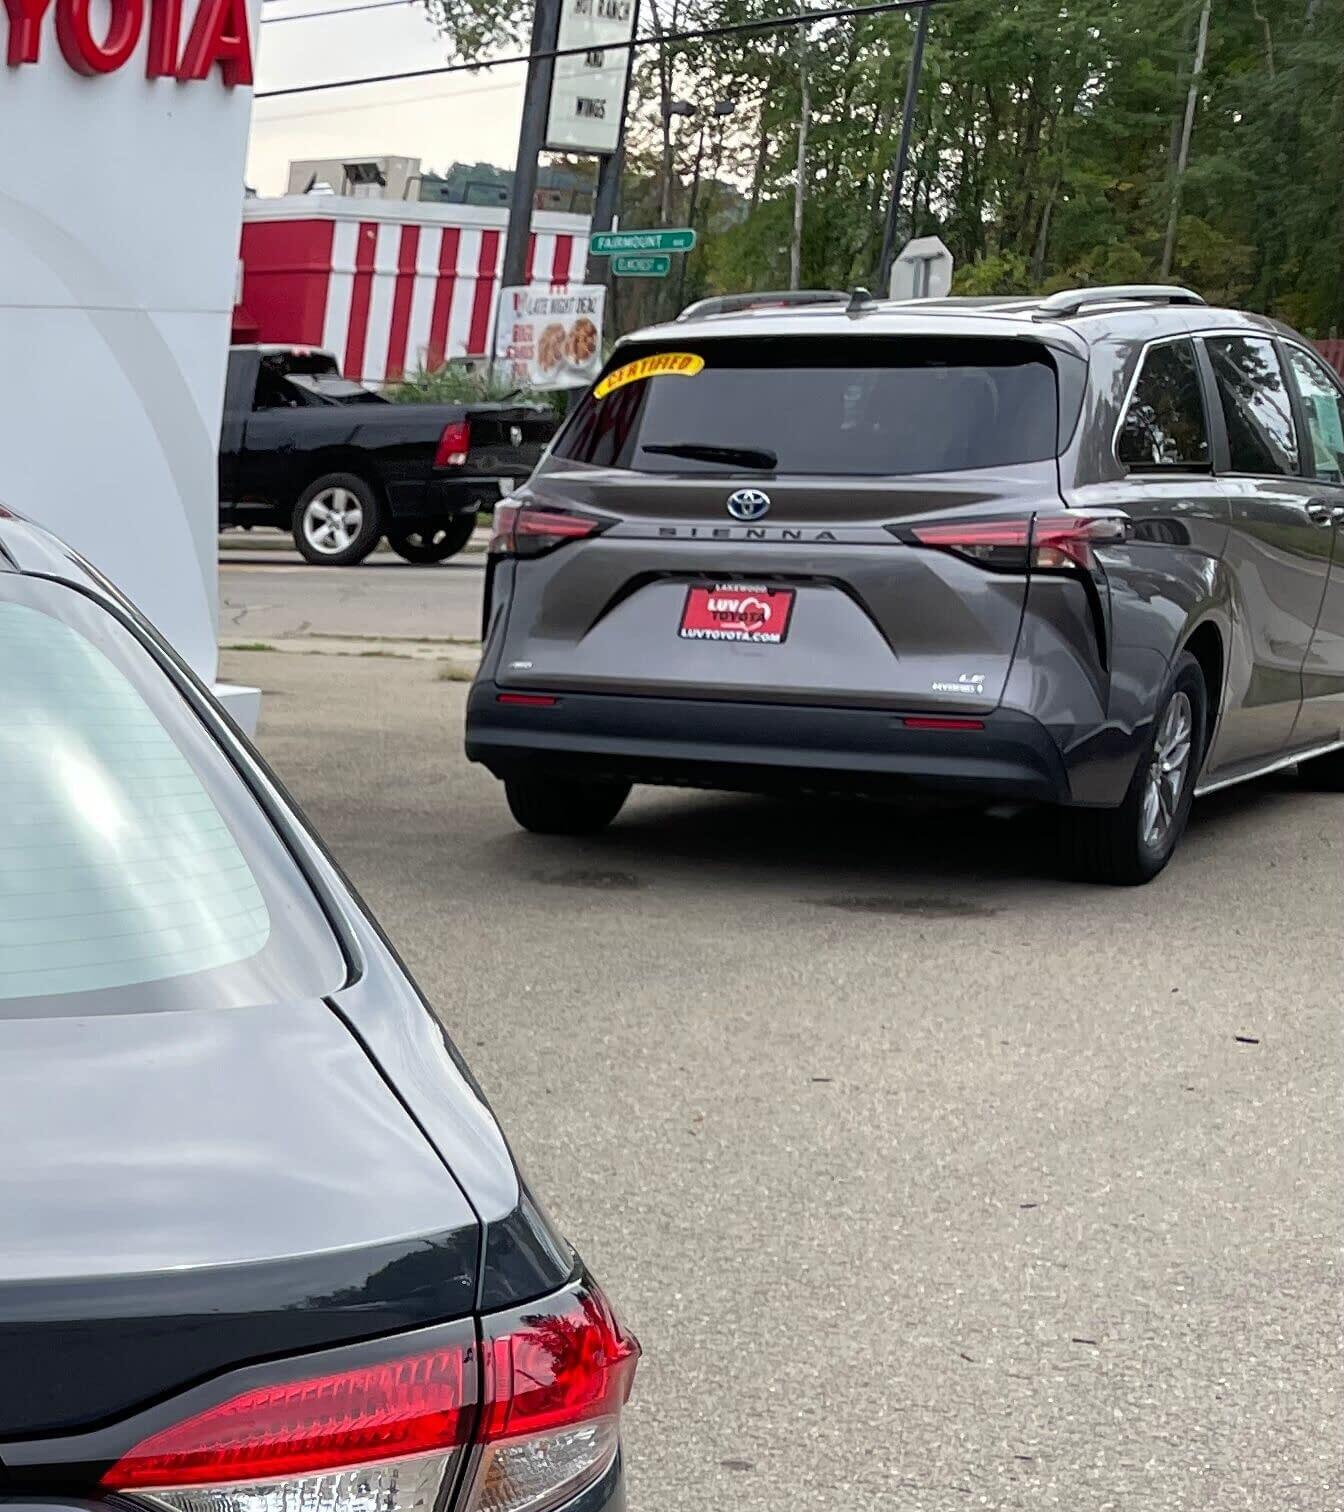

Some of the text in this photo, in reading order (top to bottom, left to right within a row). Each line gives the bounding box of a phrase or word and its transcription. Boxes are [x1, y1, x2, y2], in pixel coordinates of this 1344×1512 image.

[598, 234, 662, 250] FAIRMOUNT
[607, 356, 693, 389] CERTIFIED
[659, 527, 837, 541] SIENNA
[707, 598, 740, 612] LUV
[713, 611, 766, 623] TOYOTA
[681, 627, 781, 643] LUVTOYOTA.COM
